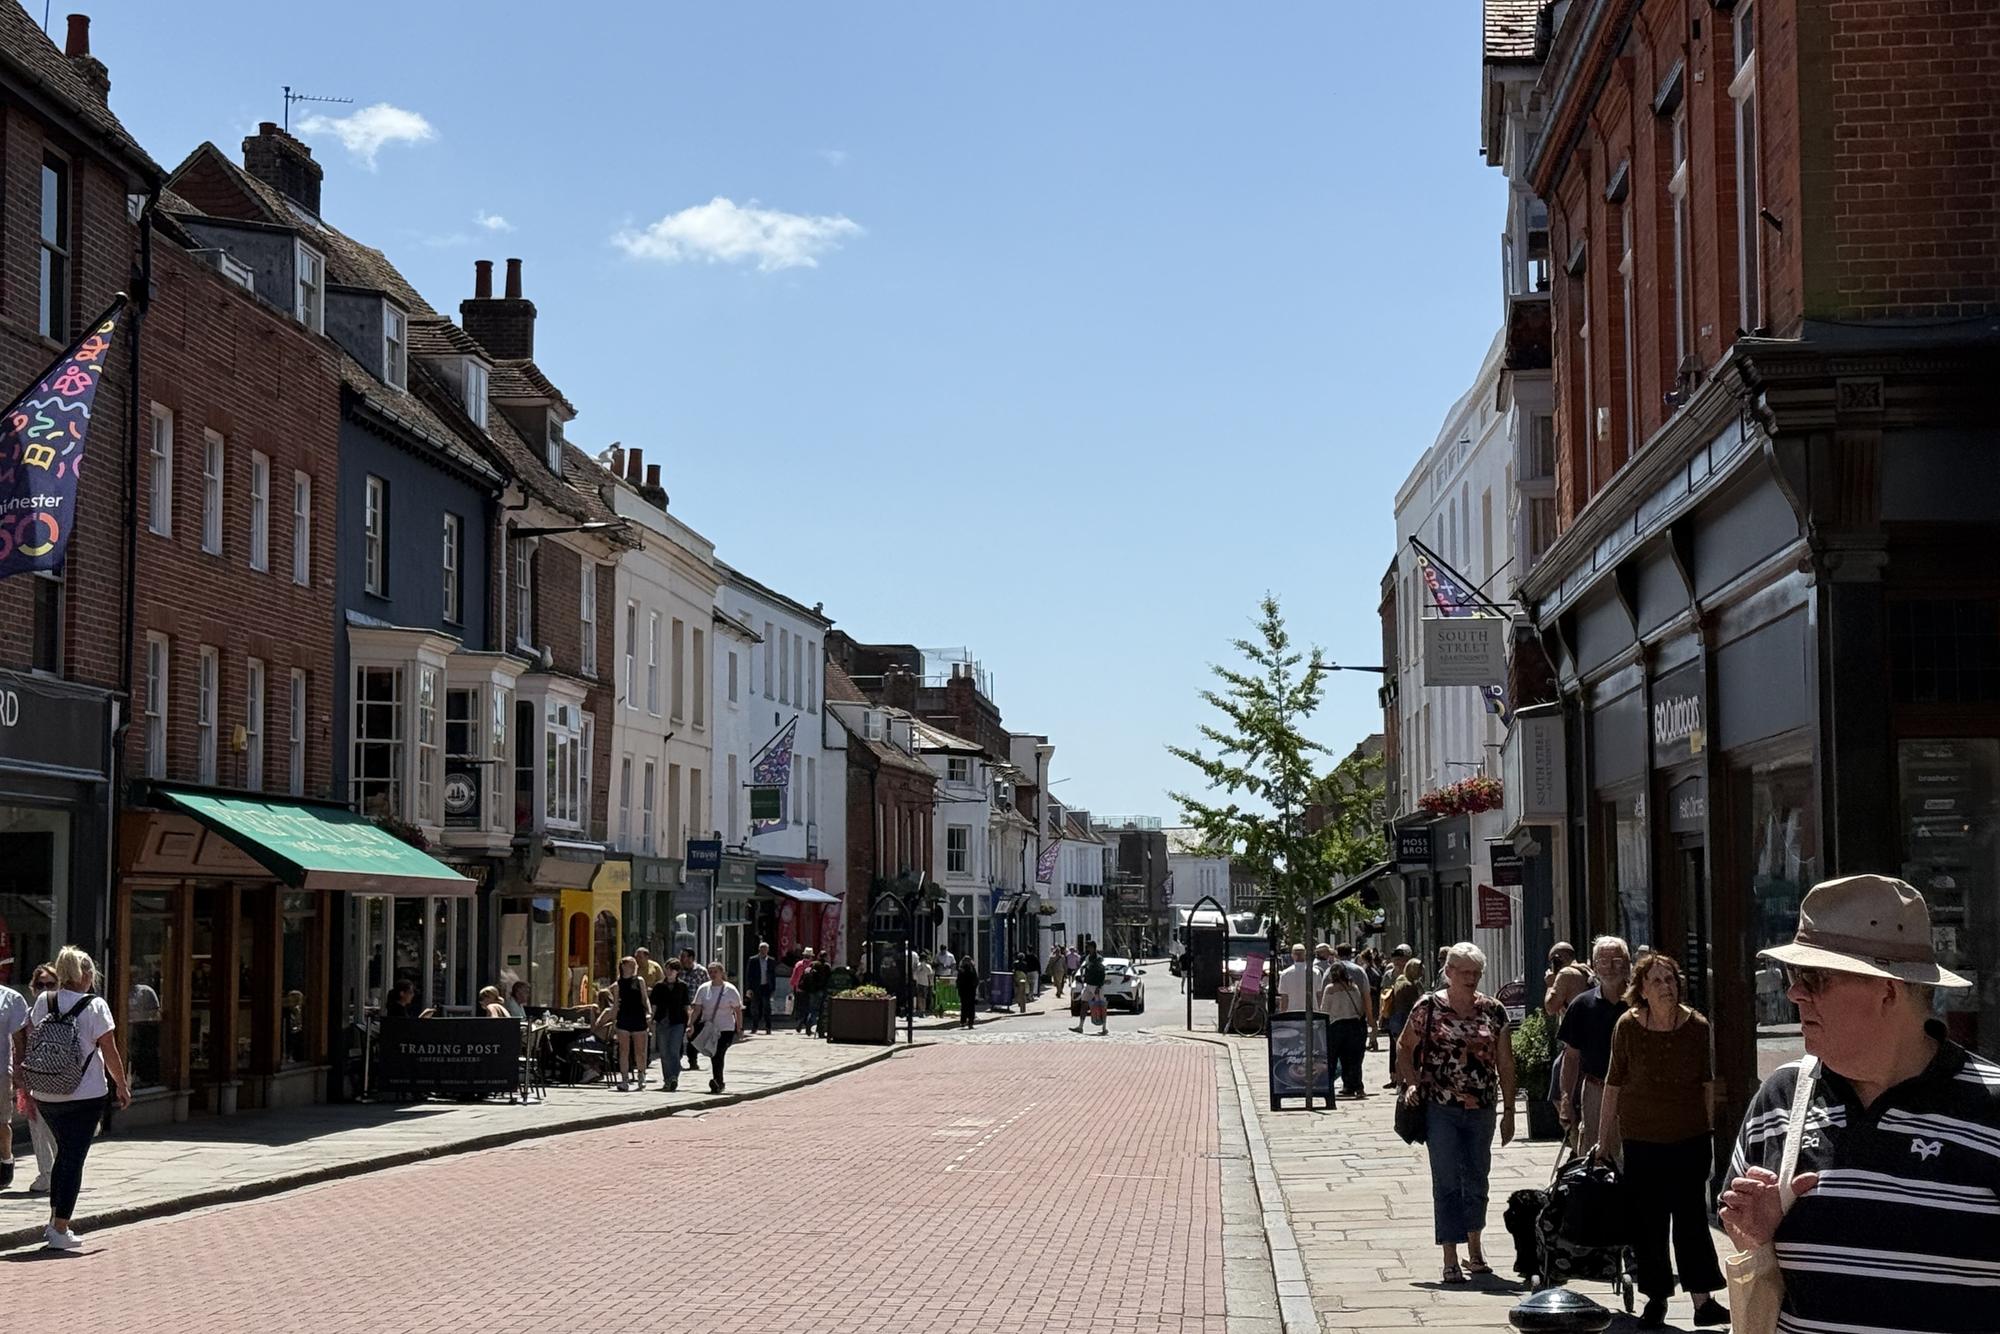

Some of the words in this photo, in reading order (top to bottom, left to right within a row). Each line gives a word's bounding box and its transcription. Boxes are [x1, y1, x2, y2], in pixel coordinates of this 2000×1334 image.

[1438, 631, 1488, 642] SOUTH
[1438, 643, 1489, 654] STREET
[1534, 725, 1544, 765] STREET
[1535, 767, 1545, 806] SOUTH
[1402, 838, 1428, 846] MOSS
[691, 850, 718, 859] Travel
[399, 1043, 461, 1055] TRADING
[467, 1043, 501, 1055] POST
